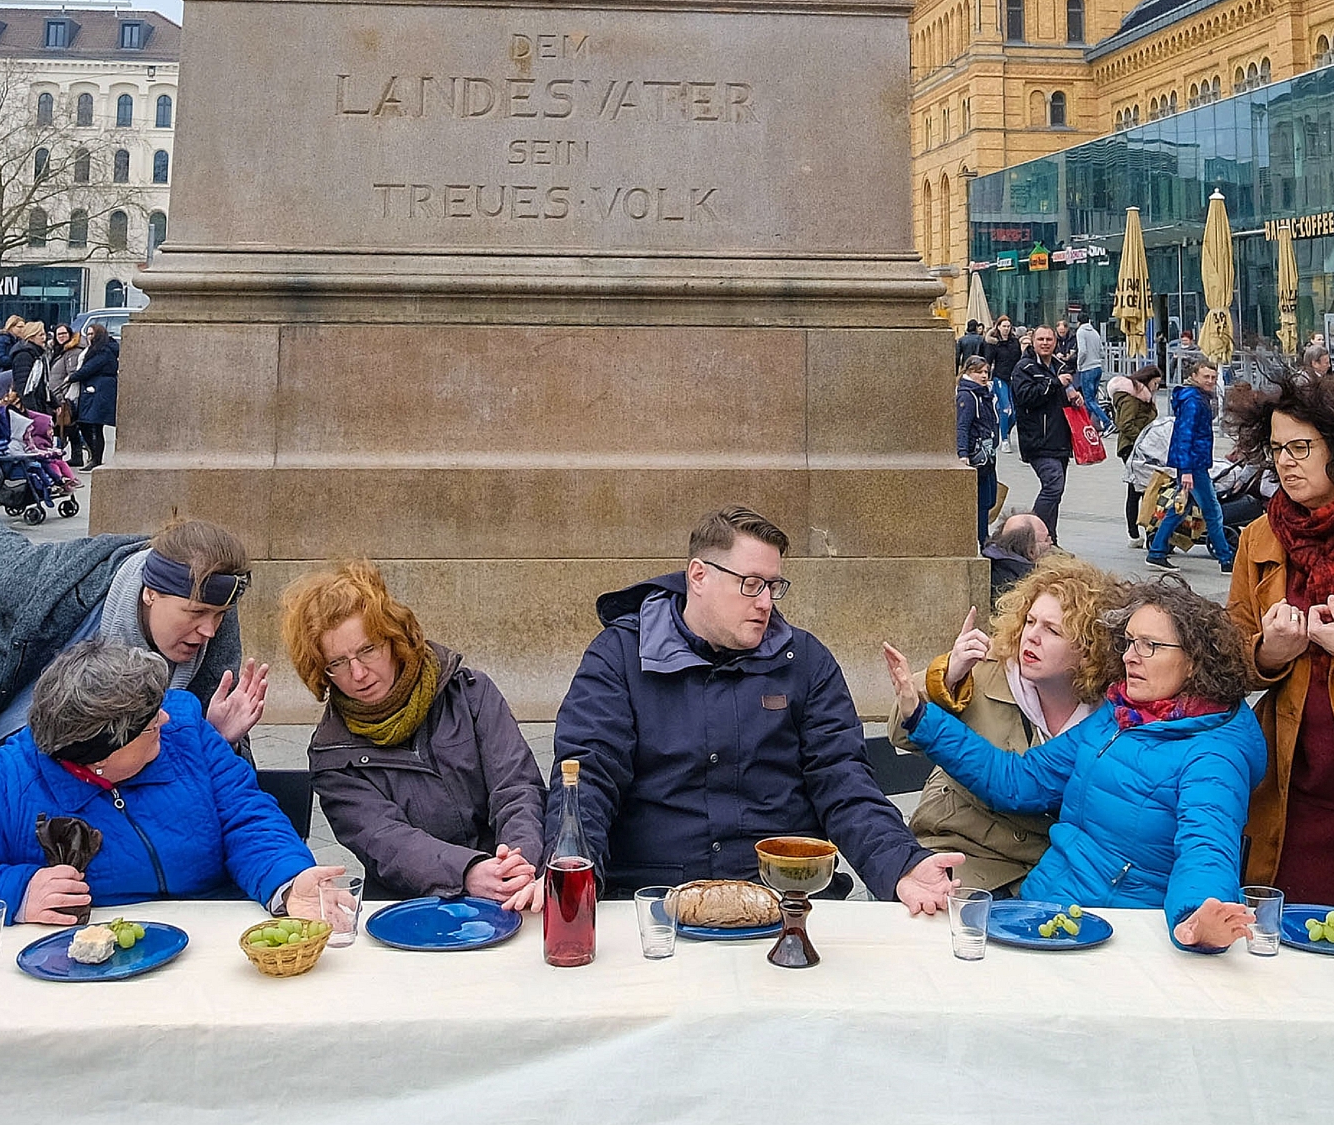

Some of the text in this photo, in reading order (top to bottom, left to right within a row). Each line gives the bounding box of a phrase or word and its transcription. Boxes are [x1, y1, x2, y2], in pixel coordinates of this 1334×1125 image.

[512, 33, 590, 60] DEM
[335, 74, 761, 124] LANDESVATER
[507, 139, 591, 165] SEIN
[373, 183, 720, 222] TREUES VOLK
[1265, 211, 1334, 241] BALAC COFFEE
